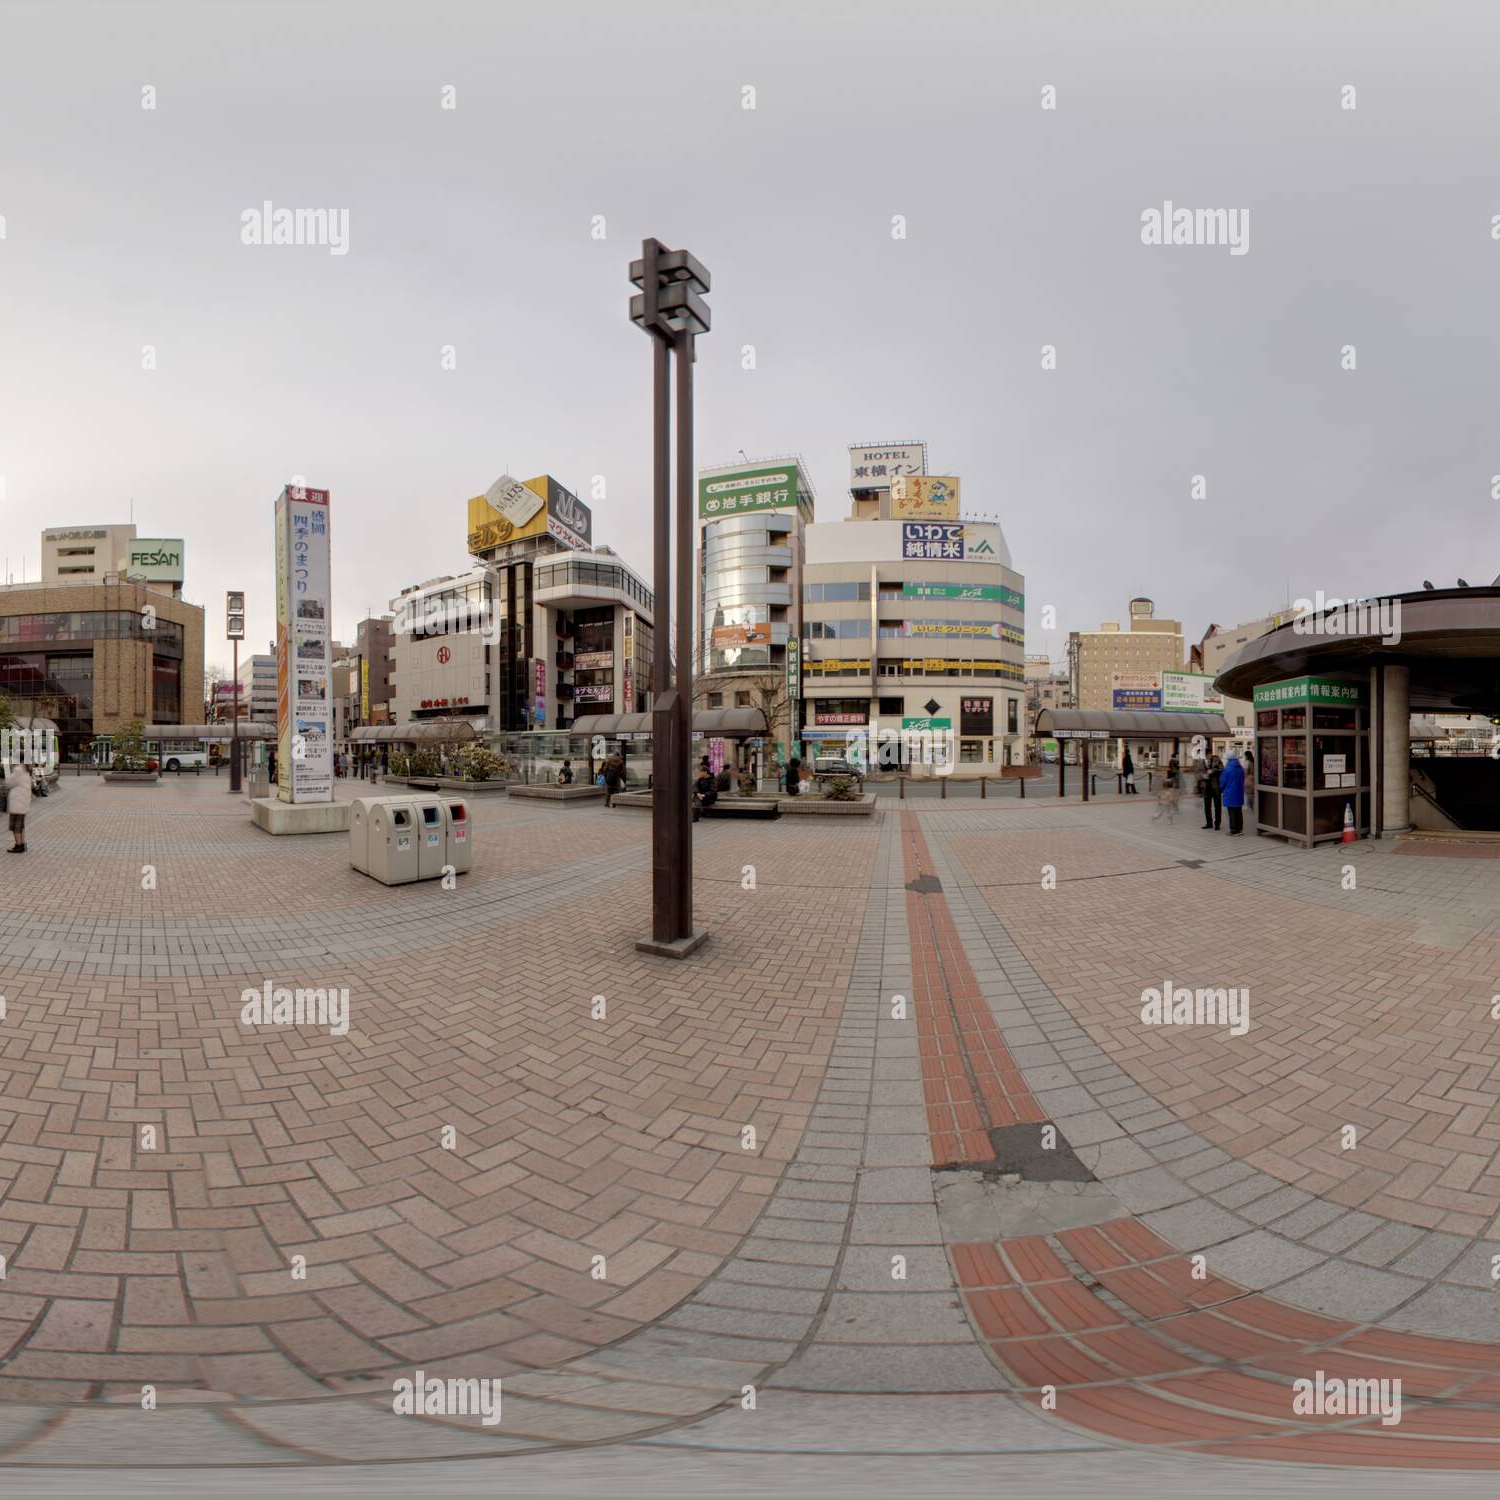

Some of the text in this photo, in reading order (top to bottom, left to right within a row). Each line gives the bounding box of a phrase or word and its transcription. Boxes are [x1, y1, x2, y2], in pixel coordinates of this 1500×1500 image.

[863, 451, 910, 461] HOTEL
[854, 464, 921, 478] 東横イン
[722, 489, 789, 510] 岩手銀行
[467, 519, 514, 549] モルツ
[906, 524, 961, 540] いわて
[131, 548, 179, 566] FESAN
[294, 514, 308, 593] 四季のまつり
[906, 541, 961, 558] 純情米
[1310, 684, 1359, 699] 情報案内盤
